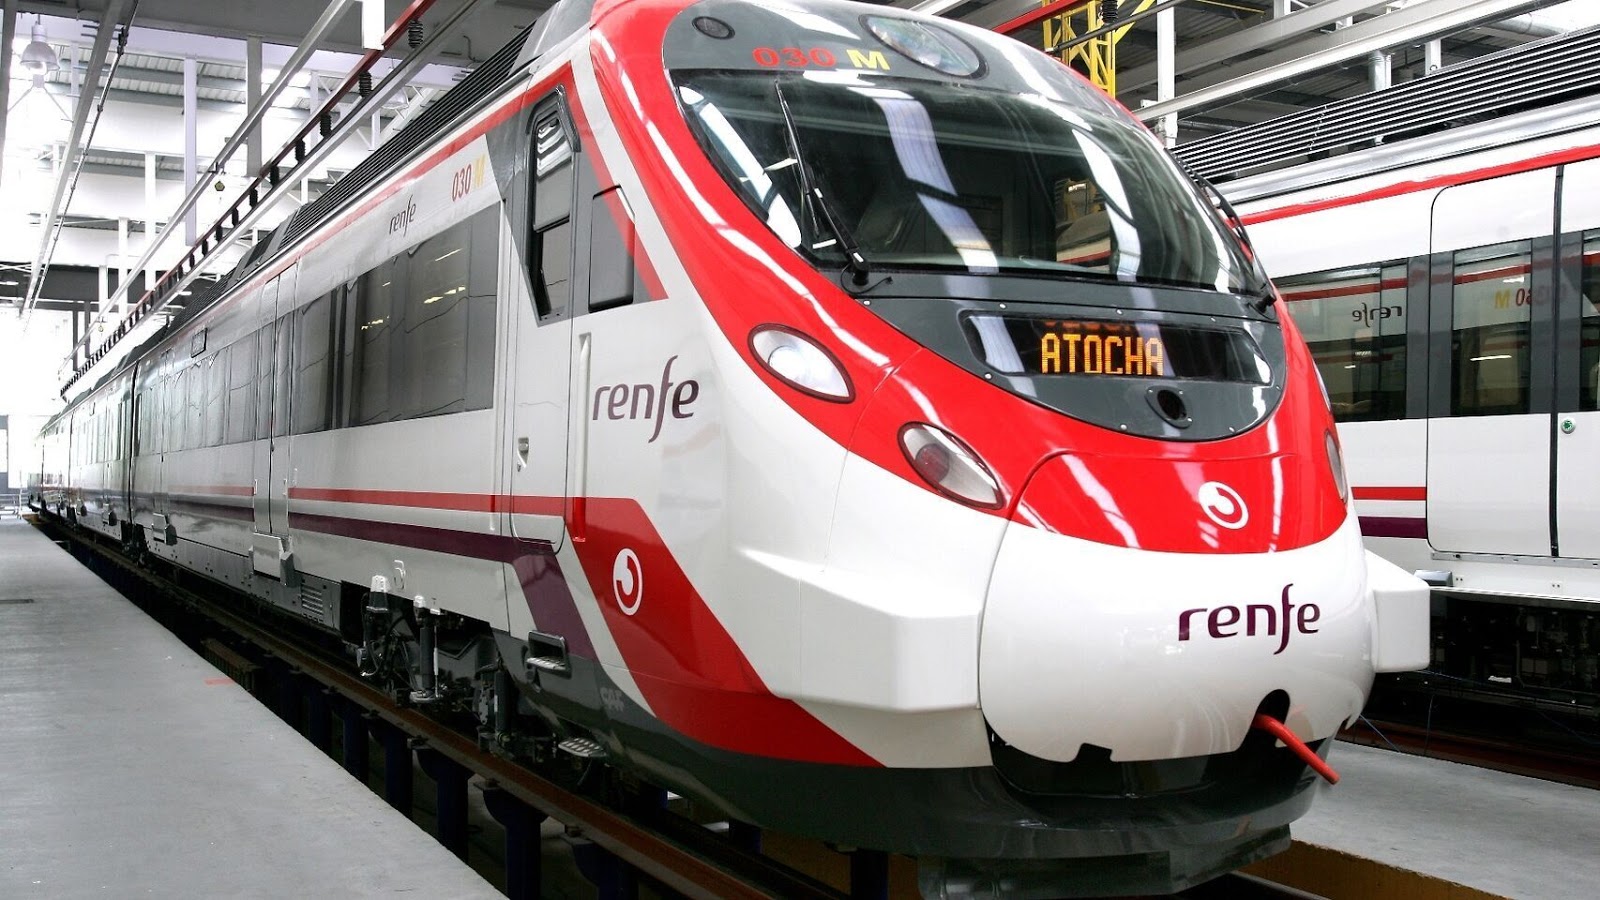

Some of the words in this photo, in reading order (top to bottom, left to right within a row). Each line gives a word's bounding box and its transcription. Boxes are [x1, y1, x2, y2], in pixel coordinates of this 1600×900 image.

[753, 47, 837, 67] 030
[846, 49, 890, 70] M
[451, 163, 472, 202] 030
[388, 193, 417, 237] renfe
[1041, 333, 1164, 376] ATOCHA
[592, 355, 699, 443] renfe
[1178, 583, 1320, 655] renfe
